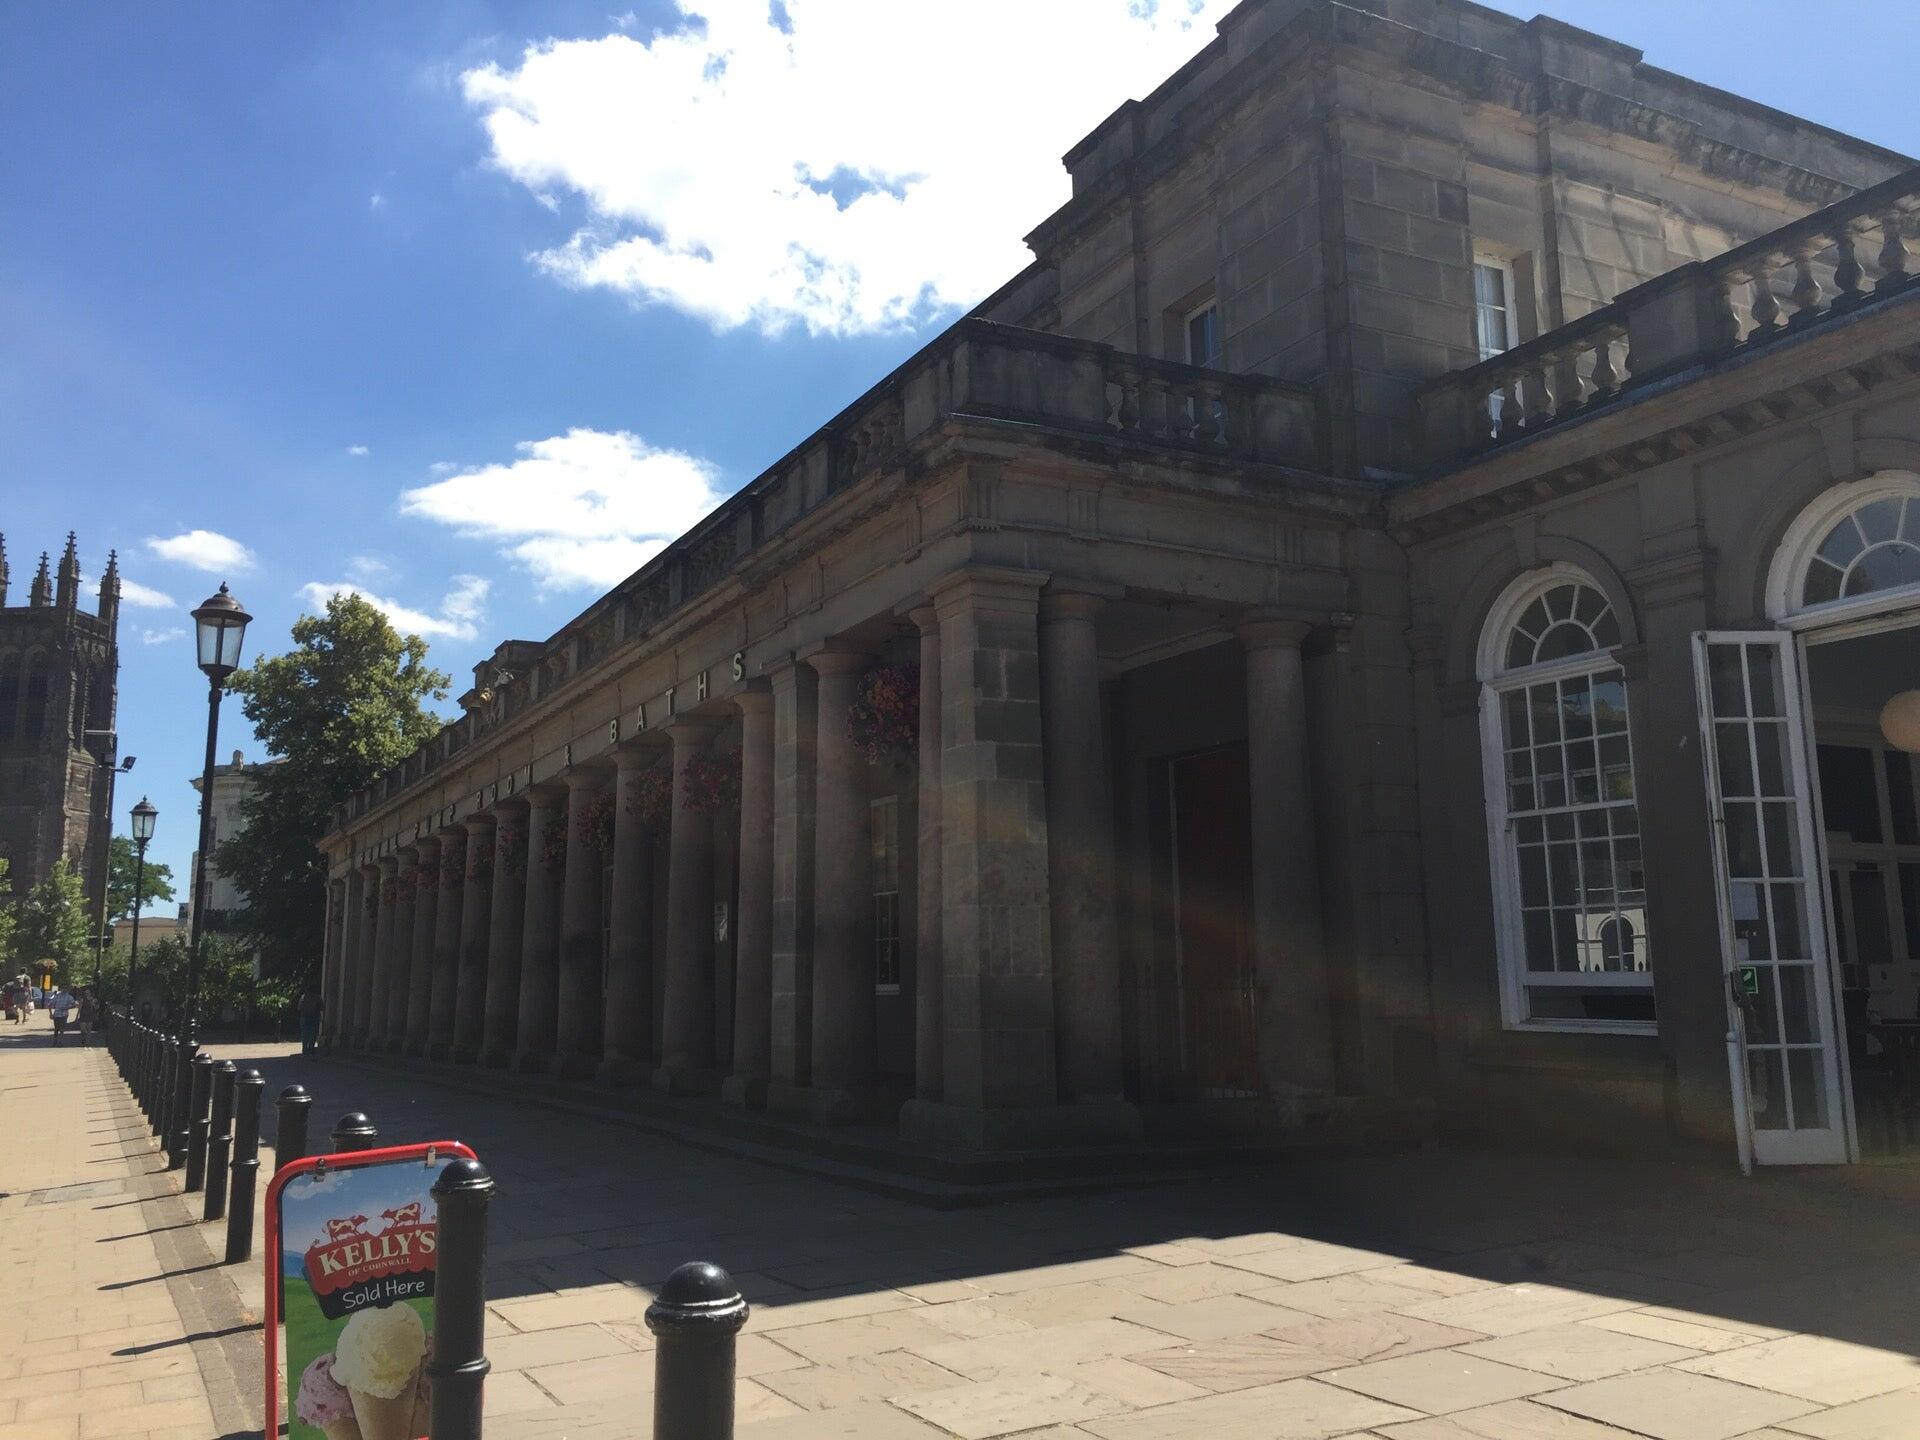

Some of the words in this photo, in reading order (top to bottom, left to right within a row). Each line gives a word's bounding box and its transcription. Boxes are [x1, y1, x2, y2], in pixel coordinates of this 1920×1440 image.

[609, 651, 743, 744] BATHS
[319, 1230, 436, 1276] KELLY'S
[348, 1268, 361, 1277] OF
[362, 1258, 412, 1273] CORNWALL
[342, 1283, 381, 1309] Sold
[385, 1280, 425, 1297] Here
